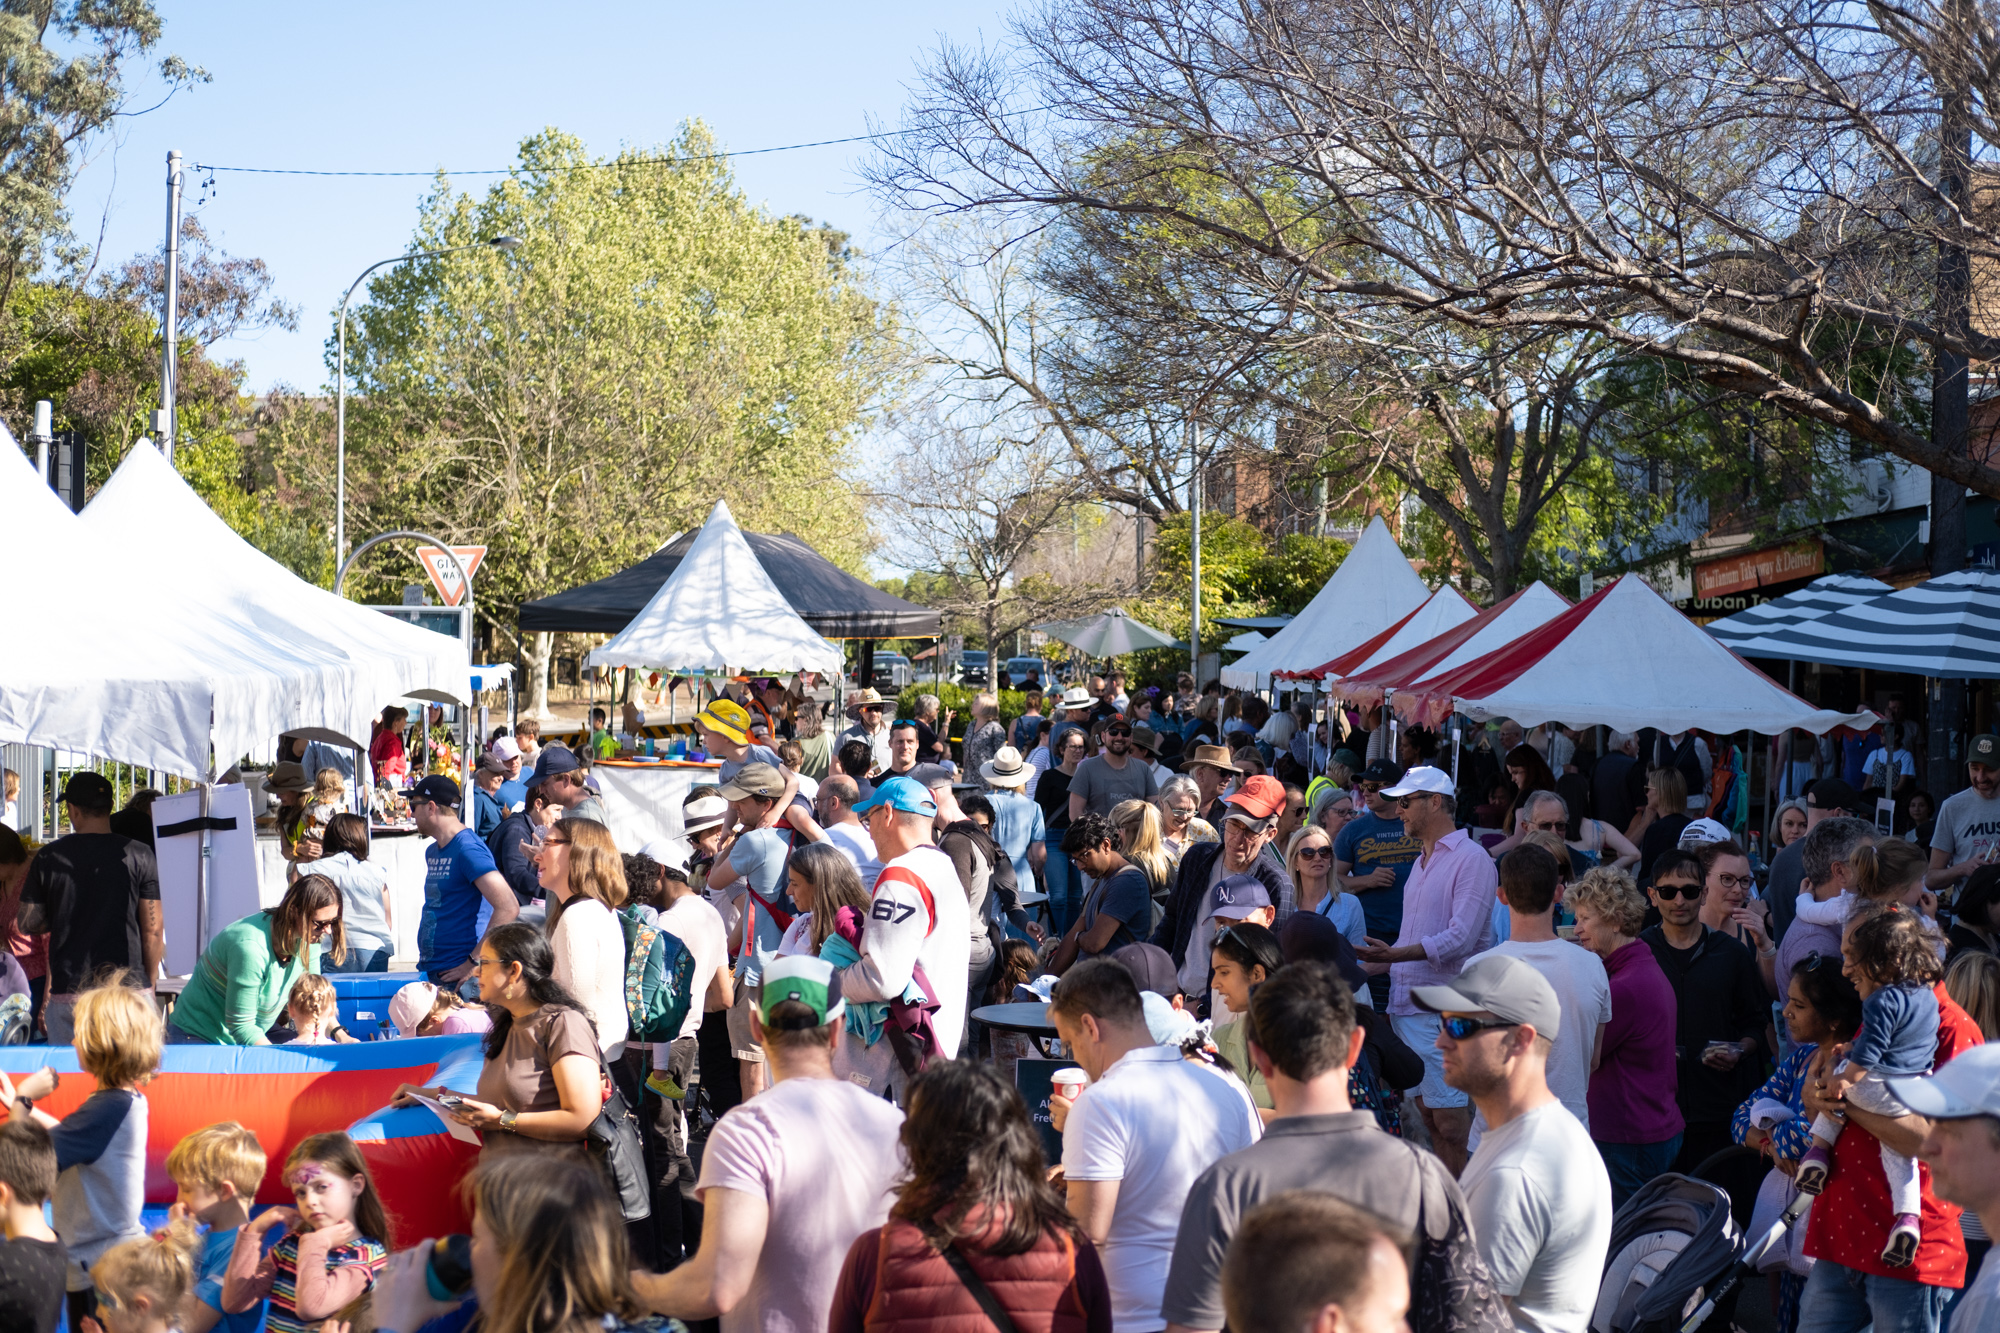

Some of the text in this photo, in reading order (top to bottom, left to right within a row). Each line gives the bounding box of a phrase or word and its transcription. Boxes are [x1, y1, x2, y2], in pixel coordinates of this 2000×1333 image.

[1776, 554, 1783, 574] &
[1784, 550, 1818, 572] Delivery
[1693, 595, 1747, 610] Urban
[872, 899, 916, 924] 67
